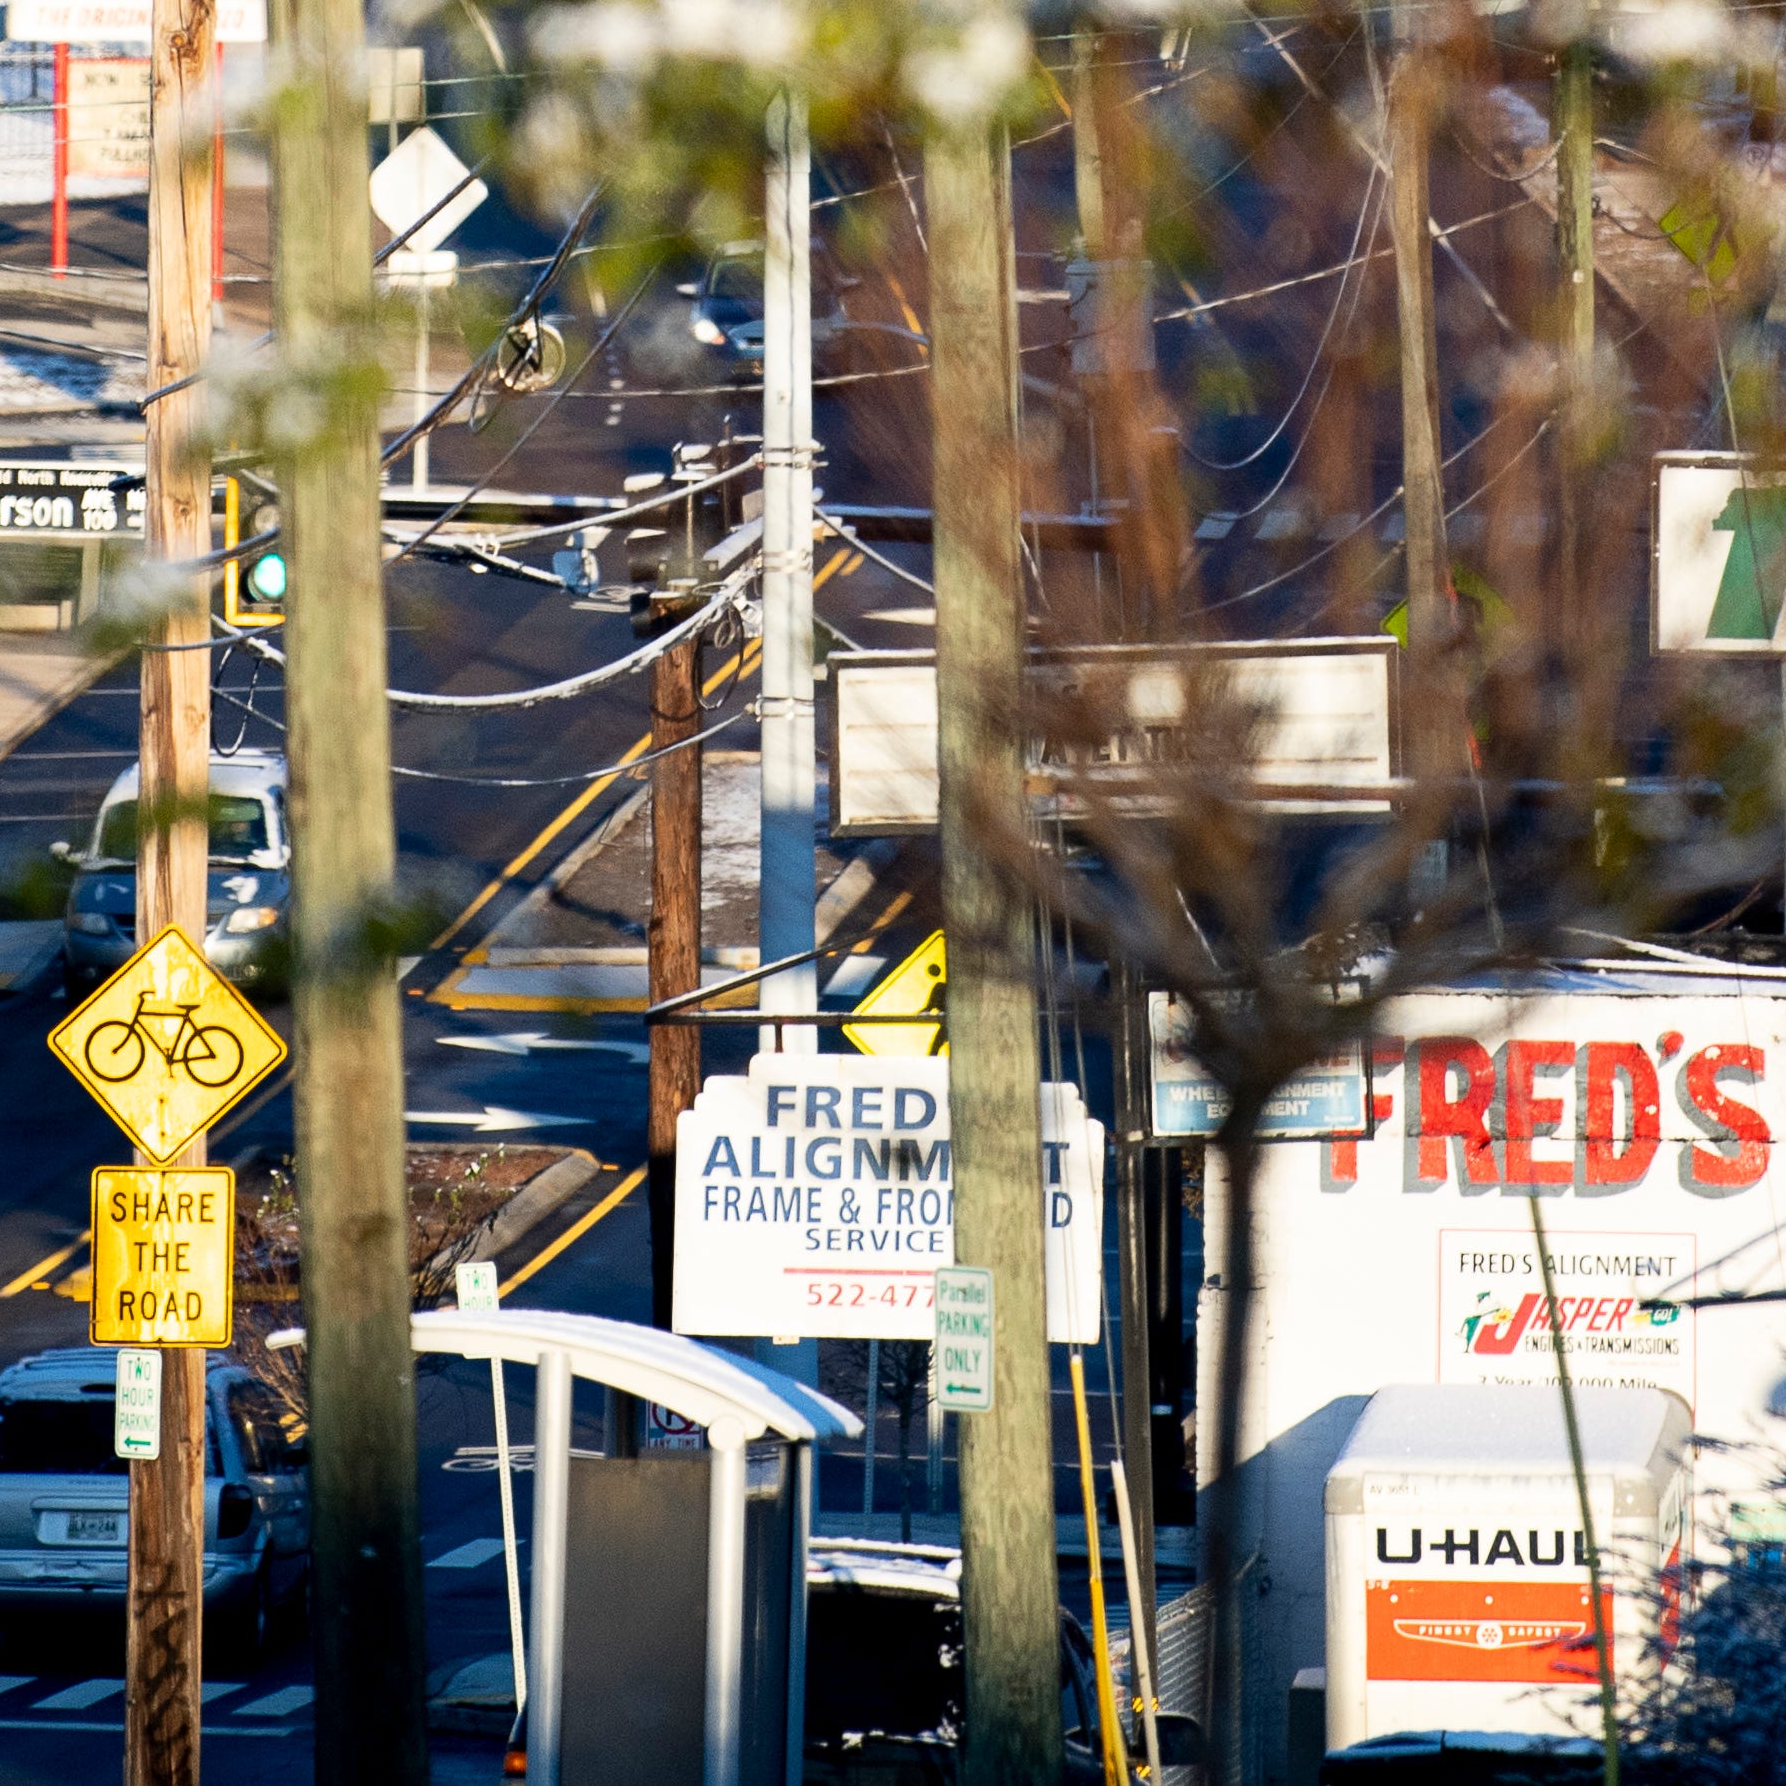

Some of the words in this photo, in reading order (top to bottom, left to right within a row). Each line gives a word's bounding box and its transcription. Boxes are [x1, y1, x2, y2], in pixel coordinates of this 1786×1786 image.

[77, 6, 152, 27] ORIGIN
[17, 468, 55, 486] North
[83, 509, 118, 531] 100
[1169, 1084, 1228, 1101] WHEE
[1319, 1029, 1772, 1199] FRED'S
[701, 1135, 1070, 1185] ALIGNMT
[111, 1191, 215, 1224] SHARE
[703, 1185, 822, 1225] FRAME
[839, 1187, 861, 1225] &
[805, 1227, 945, 1253] SERVICE
[134, 1241, 190, 1274] THE
[1459, 1253, 1533, 1274] FRED'S
[1545, 1254, 1678, 1277] ALIGNMENT
[118, 1290, 203, 1323] ROAD
[806, 1283, 935, 1308] 522-477
[938, 1309, 991, 1338] PARKING
[944, 1346, 982, 1373] ONLY
[1586, 1339, 1680, 1356] TRANSMISSIONS
[127, 1359, 152, 1382] TWO
[122, 1387, 153, 1407] HOUR
[119, 1414, 155, 1432] PARKING
[1376, 1527, 1602, 1567] U-HAUL
[1418, 1625, 1472, 1636] FINEST
[1508, 1625, 1562, 1637] SAFEST
